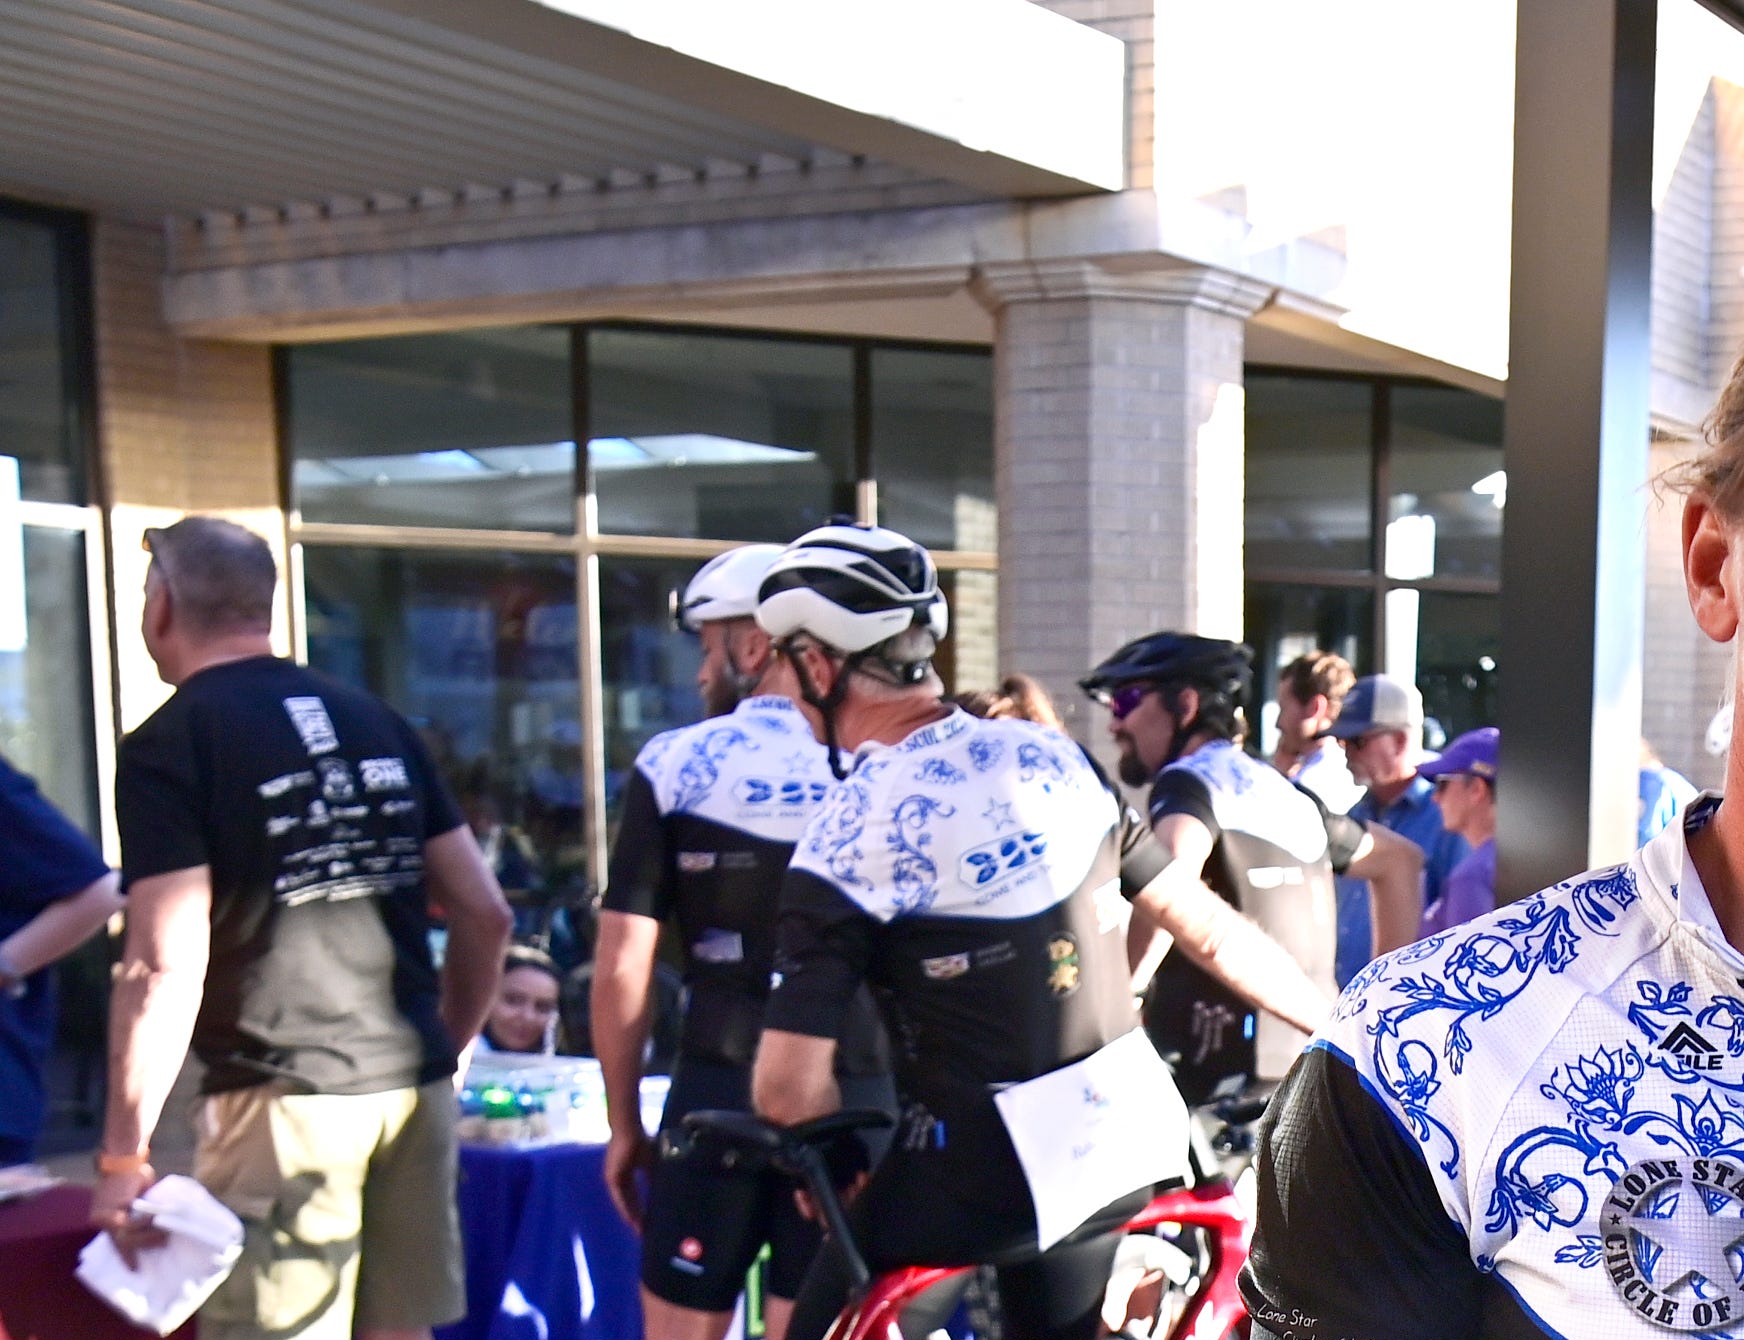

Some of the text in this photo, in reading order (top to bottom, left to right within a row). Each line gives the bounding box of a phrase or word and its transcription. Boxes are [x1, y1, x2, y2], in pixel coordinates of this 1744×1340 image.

[1609, 1160, 1682, 1213] LONE
[1605, 1233, 1680, 1325] CIRCLE
[1692, 1296, 1731, 1326] OF
[1257, 1304, 1318, 1328] Lone Star
